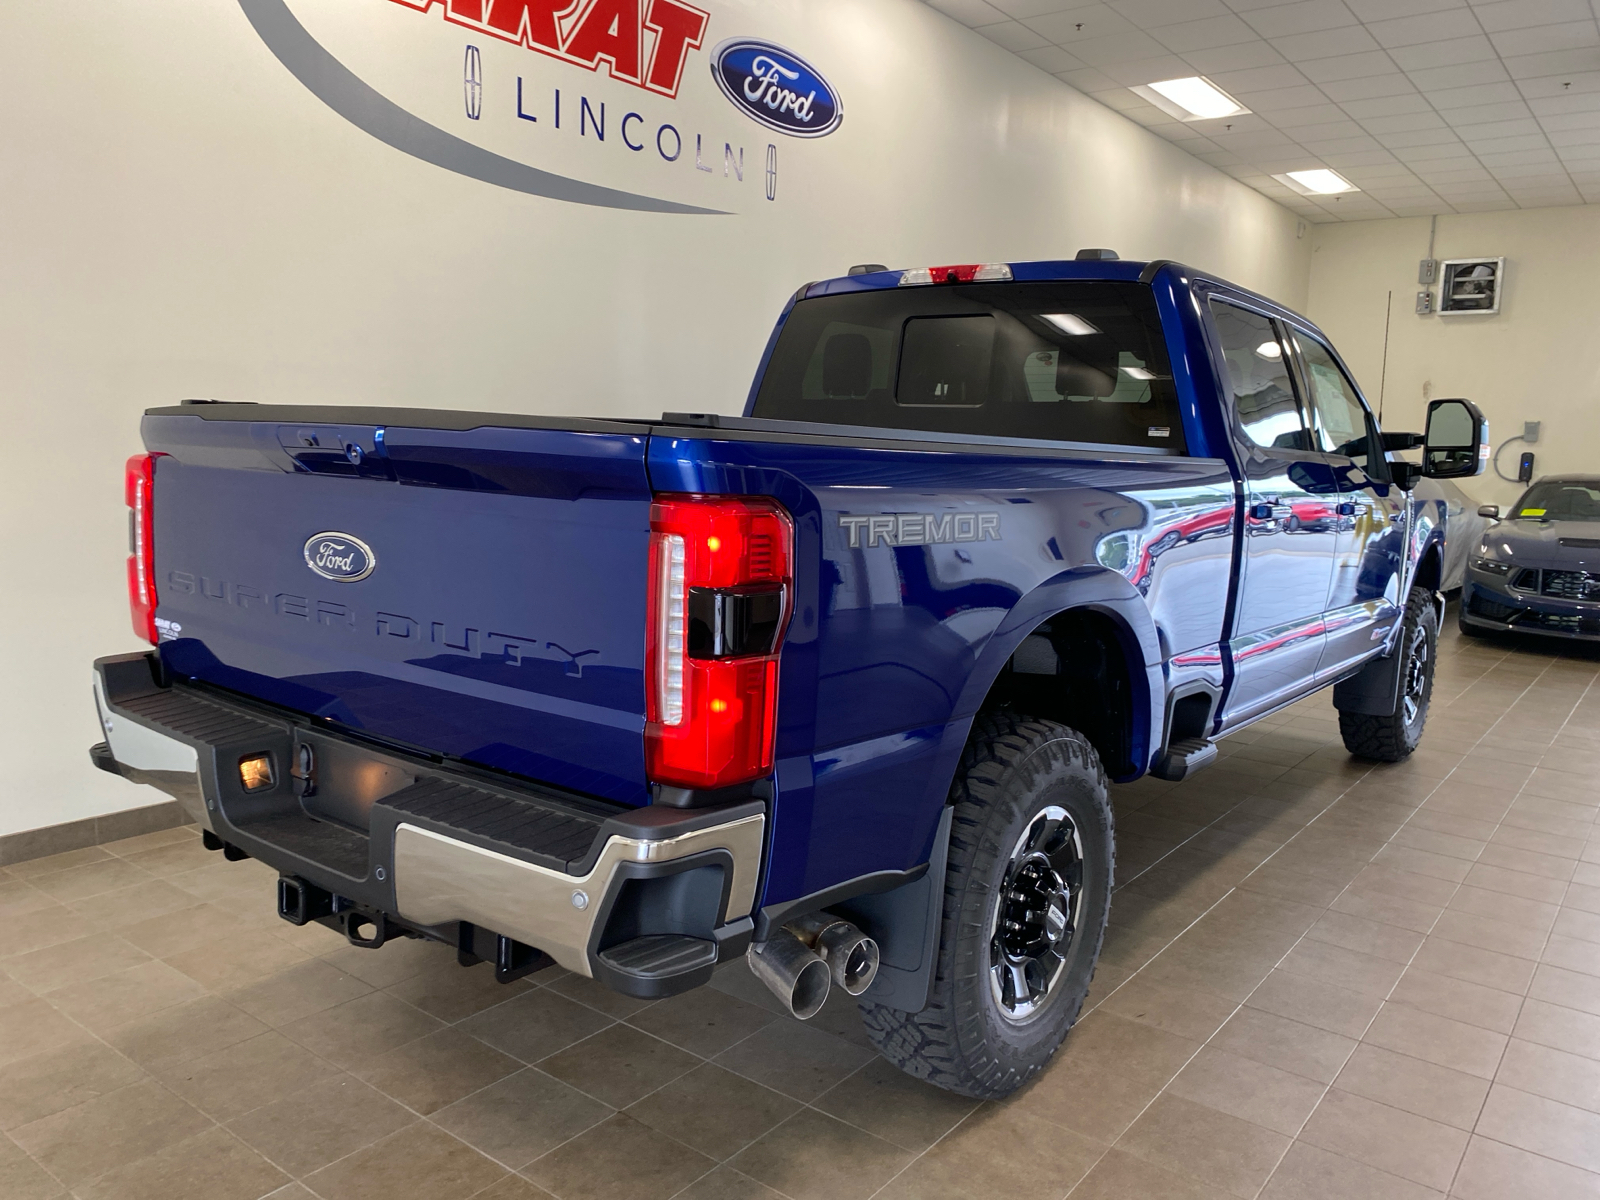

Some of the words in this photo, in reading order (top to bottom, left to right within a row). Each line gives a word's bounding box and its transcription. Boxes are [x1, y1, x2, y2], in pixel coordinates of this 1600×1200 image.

[387, 0, 710, 99] RAT
[743, 55, 816, 122] Ford
[516, 76, 744, 182] LINCOLN
[316, 541, 355, 571] Ford
[837, 511, 1002, 548] TREMOR
[168, 570, 357, 631] SUPER
[376, 611, 600, 679] DUTY
